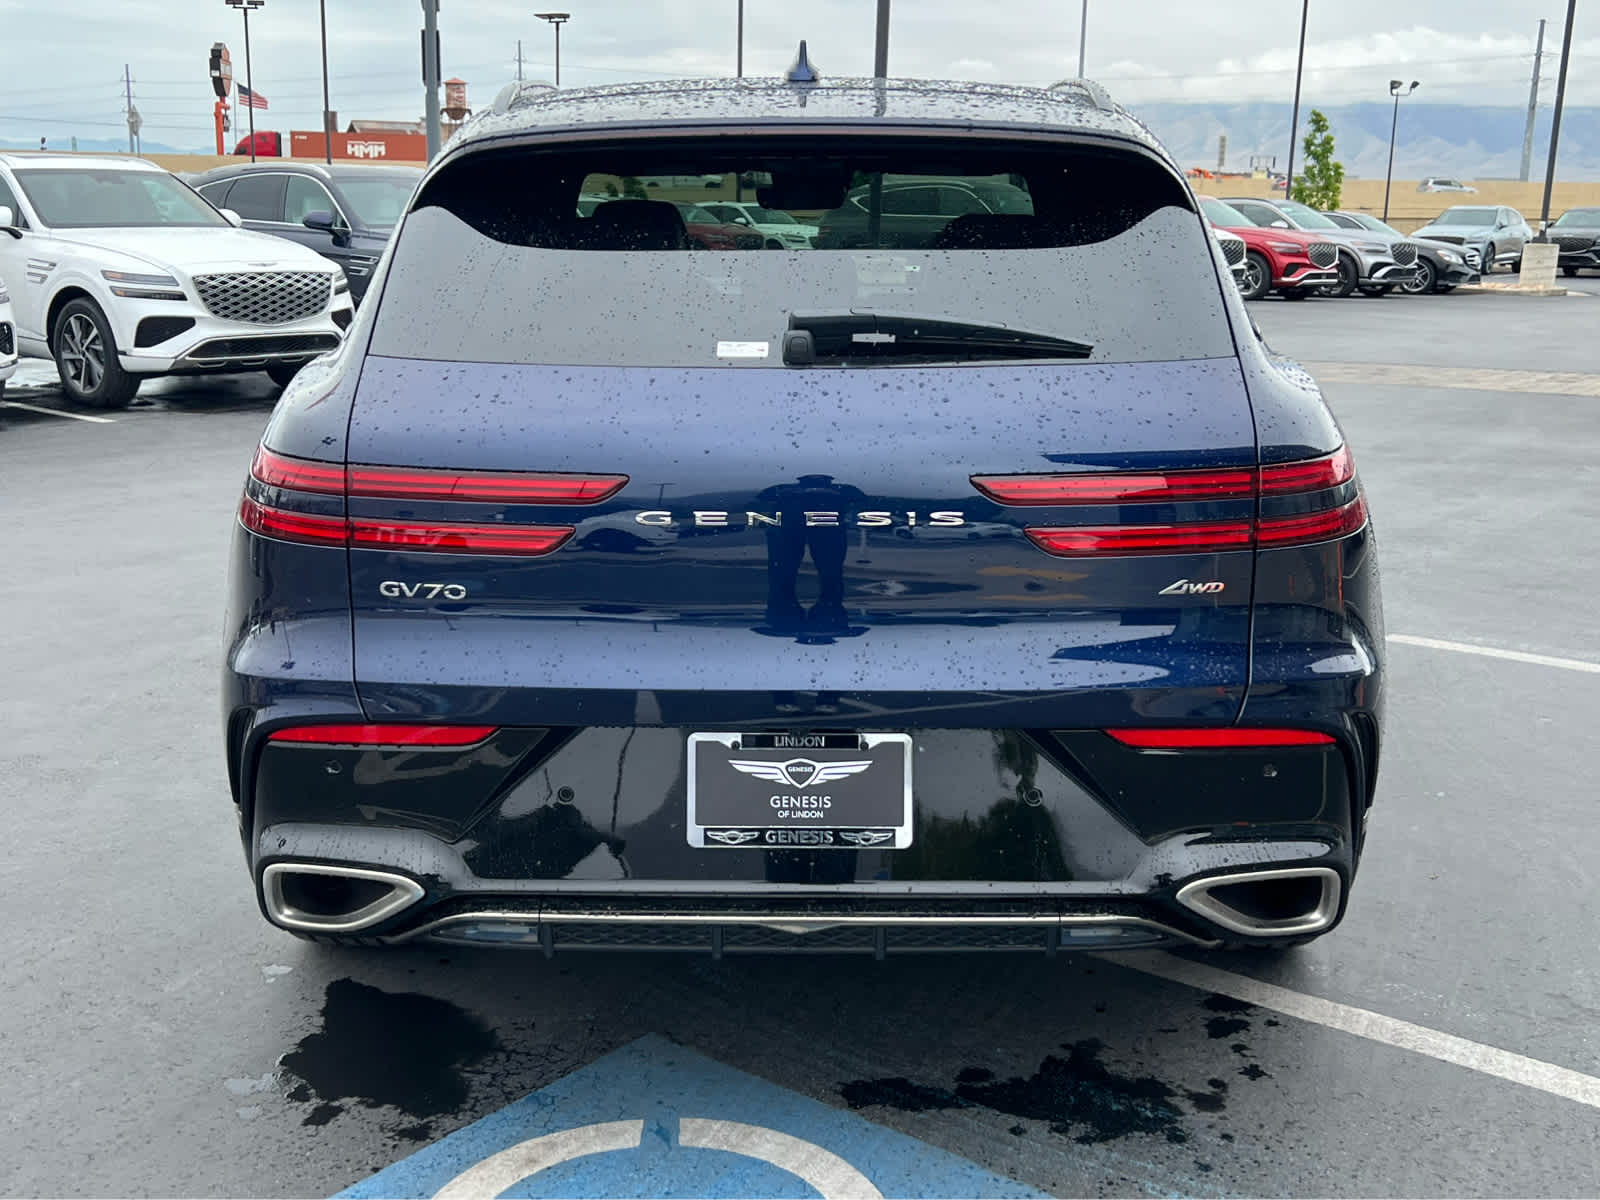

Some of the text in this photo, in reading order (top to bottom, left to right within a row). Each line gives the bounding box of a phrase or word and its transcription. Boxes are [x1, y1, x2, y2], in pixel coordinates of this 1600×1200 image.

[634, 510, 965, 527] GENESIS
[379, 581, 467, 600] GV70
[774, 736, 825, 748] LINDON
[769, 795, 832, 809] GENESIS
[777, 811, 824, 819] OF LINDON
[765, 830, 834, 845] GENESIS
